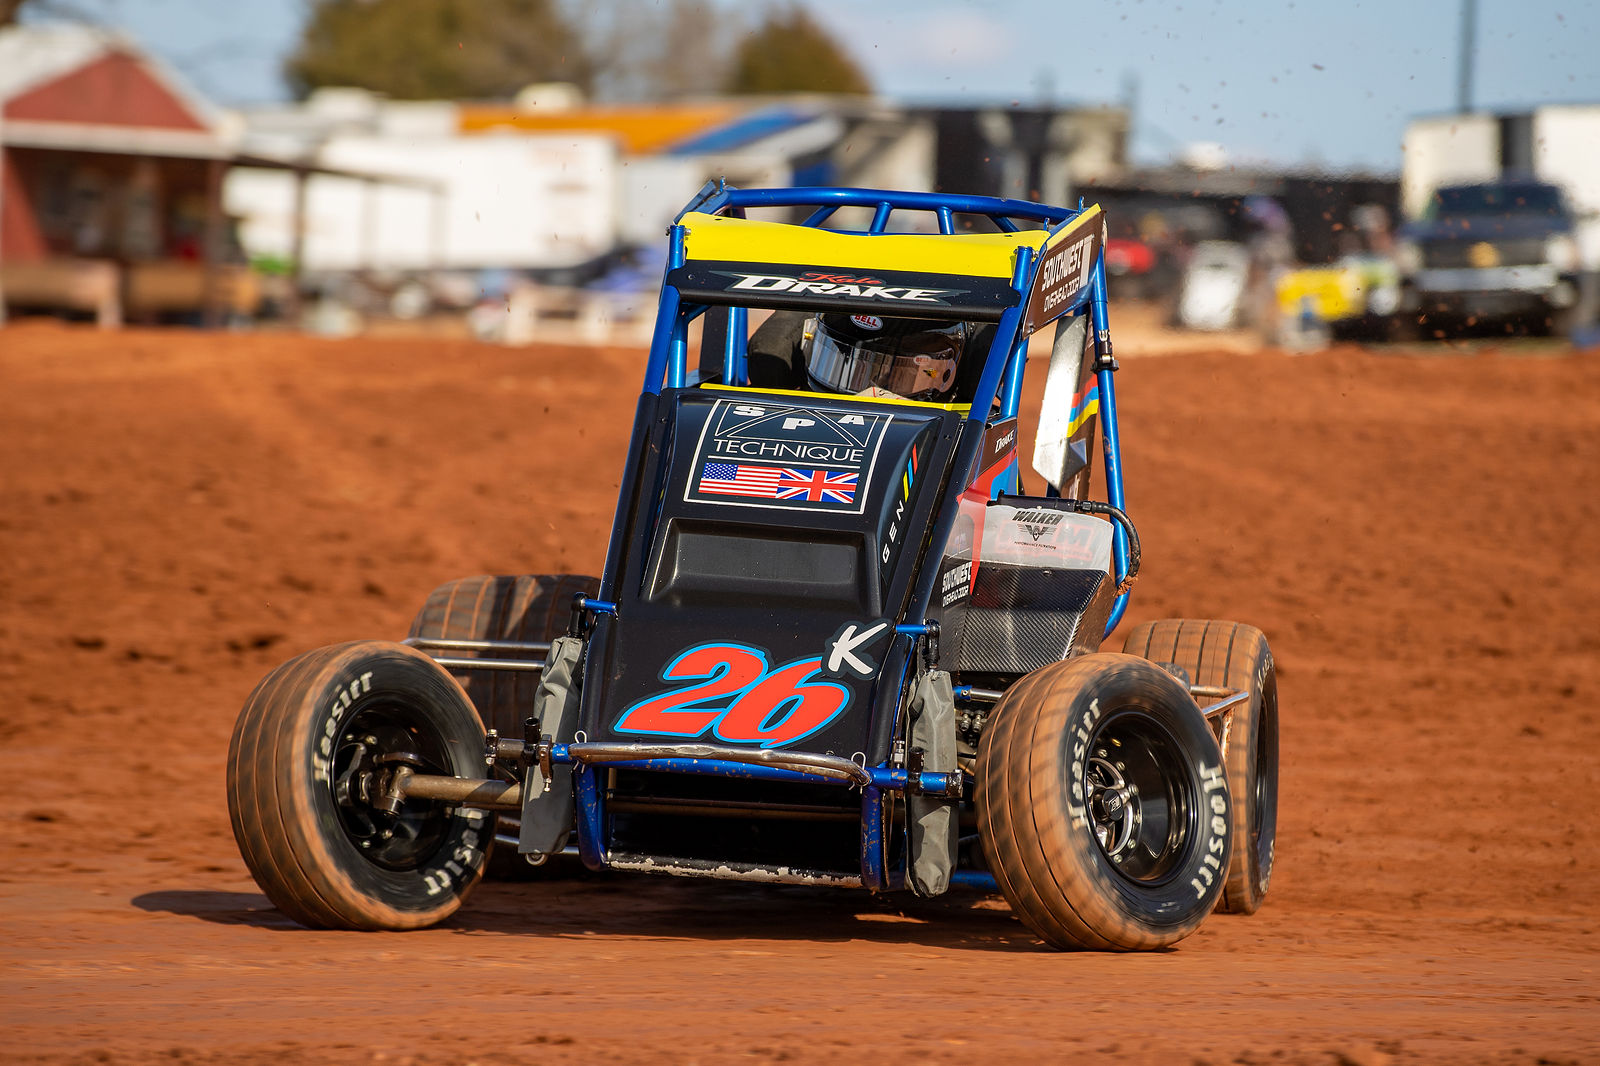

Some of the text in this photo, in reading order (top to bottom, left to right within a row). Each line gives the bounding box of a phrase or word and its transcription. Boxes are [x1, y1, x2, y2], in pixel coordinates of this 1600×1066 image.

[1041, 238, 1084, 292] SOUTHWEST
[732, 273, 950, 302] DRAKE
[854, 314, 878, 327] BELL
[713, 438, 865, 463] TECHNIQUE
[994, 429, 1015, 454] DRAKE
[1012, 510, 1064, 526] WALKER
[613, 622, 888, 749] 26 K
